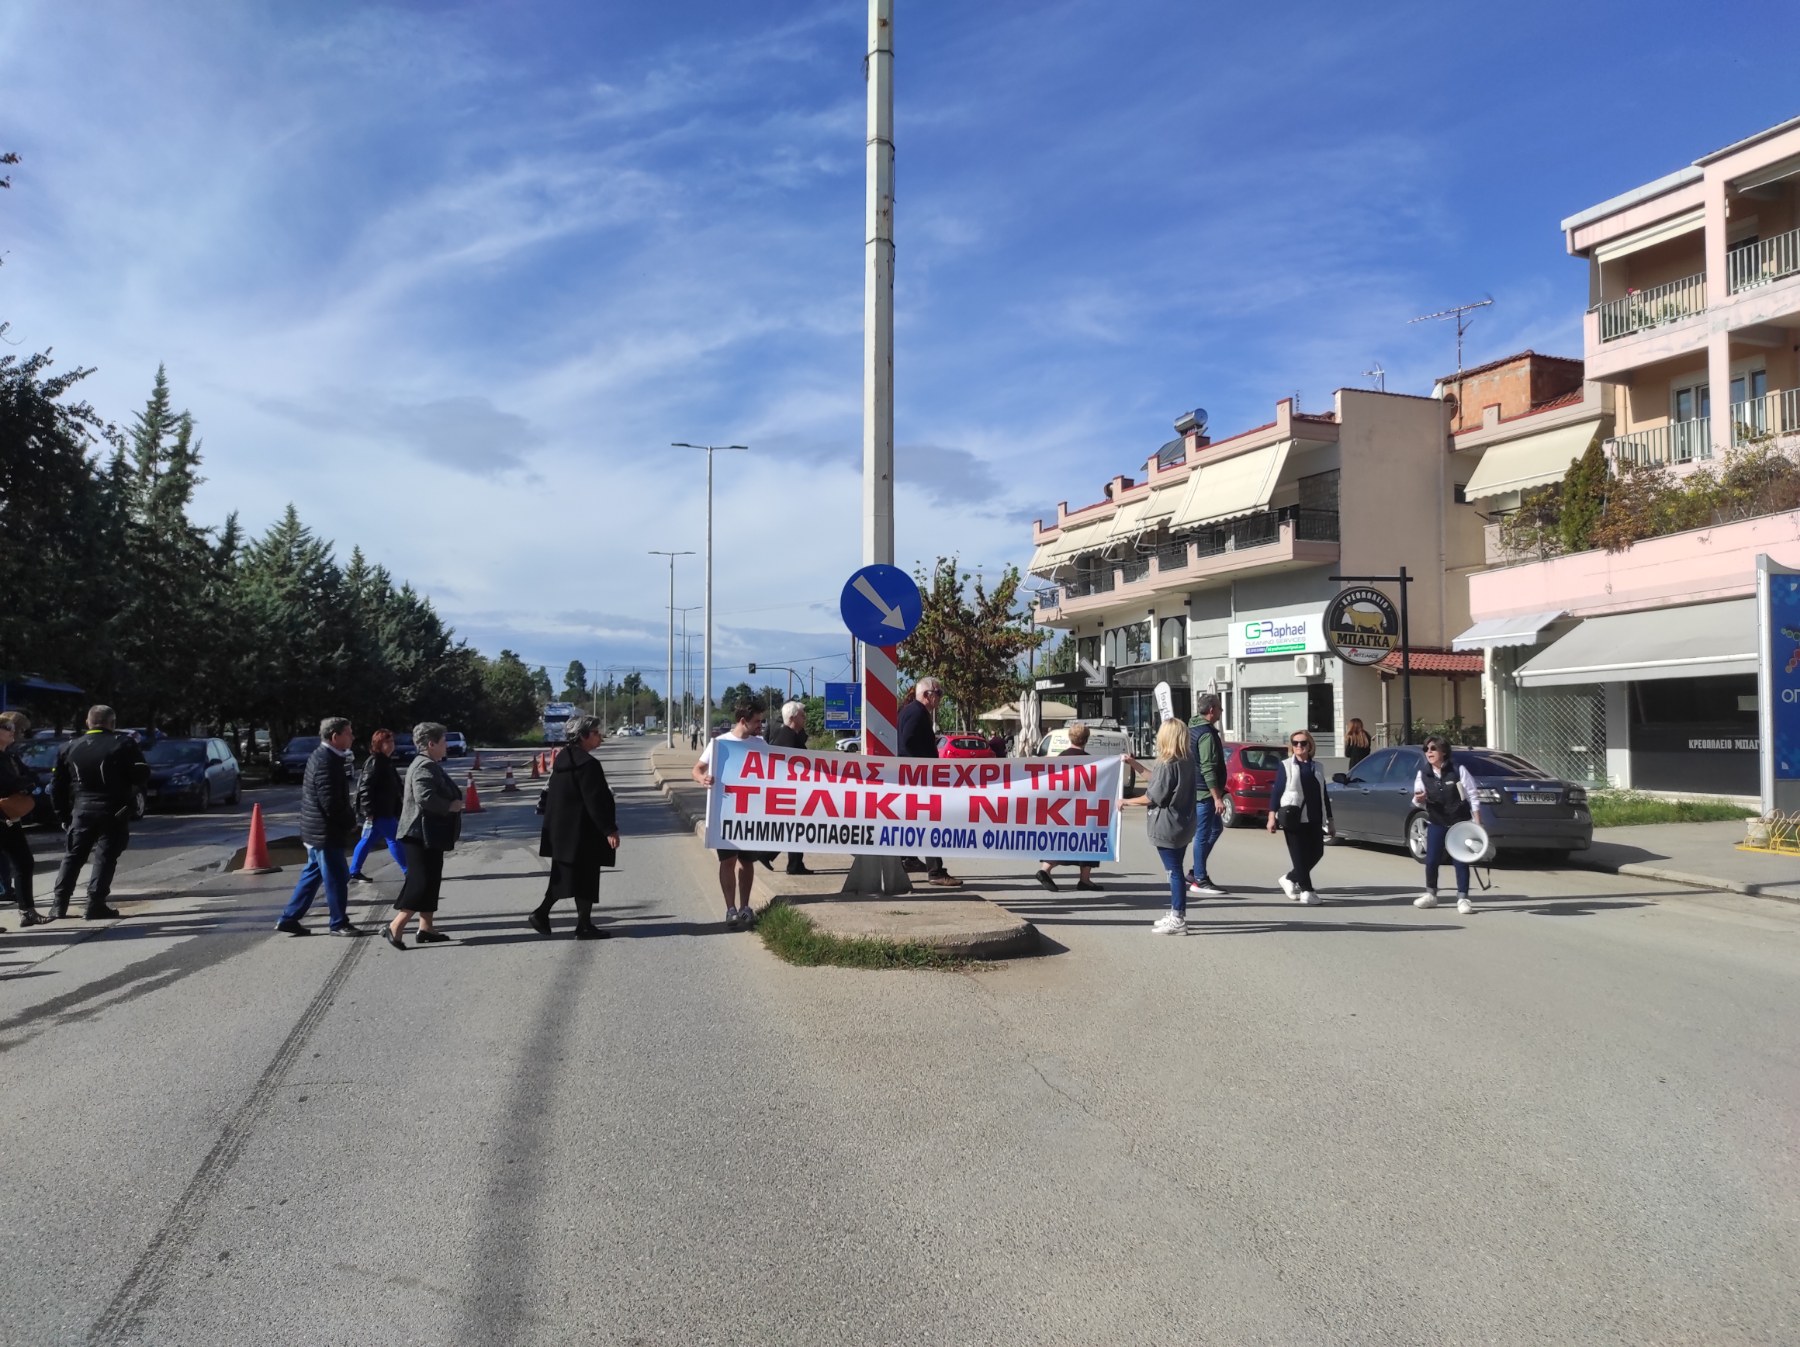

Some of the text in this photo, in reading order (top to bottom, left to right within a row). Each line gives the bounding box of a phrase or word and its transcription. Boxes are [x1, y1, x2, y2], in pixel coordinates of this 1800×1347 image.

[1337, 633, 1390, 648] ΜΠΑΓΚΑ
[740, 751, 1097, 792] ΑΓΩΝΑΣ ΜΕΧΡΙ ΤΗΝ
[725, 785, 1110, 827] ΤΕΛΙΚΗ ΝΙΚΗ
[722, 819, 1109, 853] ΠΛΗΜΜΥΡΟΠΑΘΕΙΣ ΑΓΙΟΥ ΘΩΜΑ ΦΙΛΙΠΠΟΥΠΟΛΗΣ
